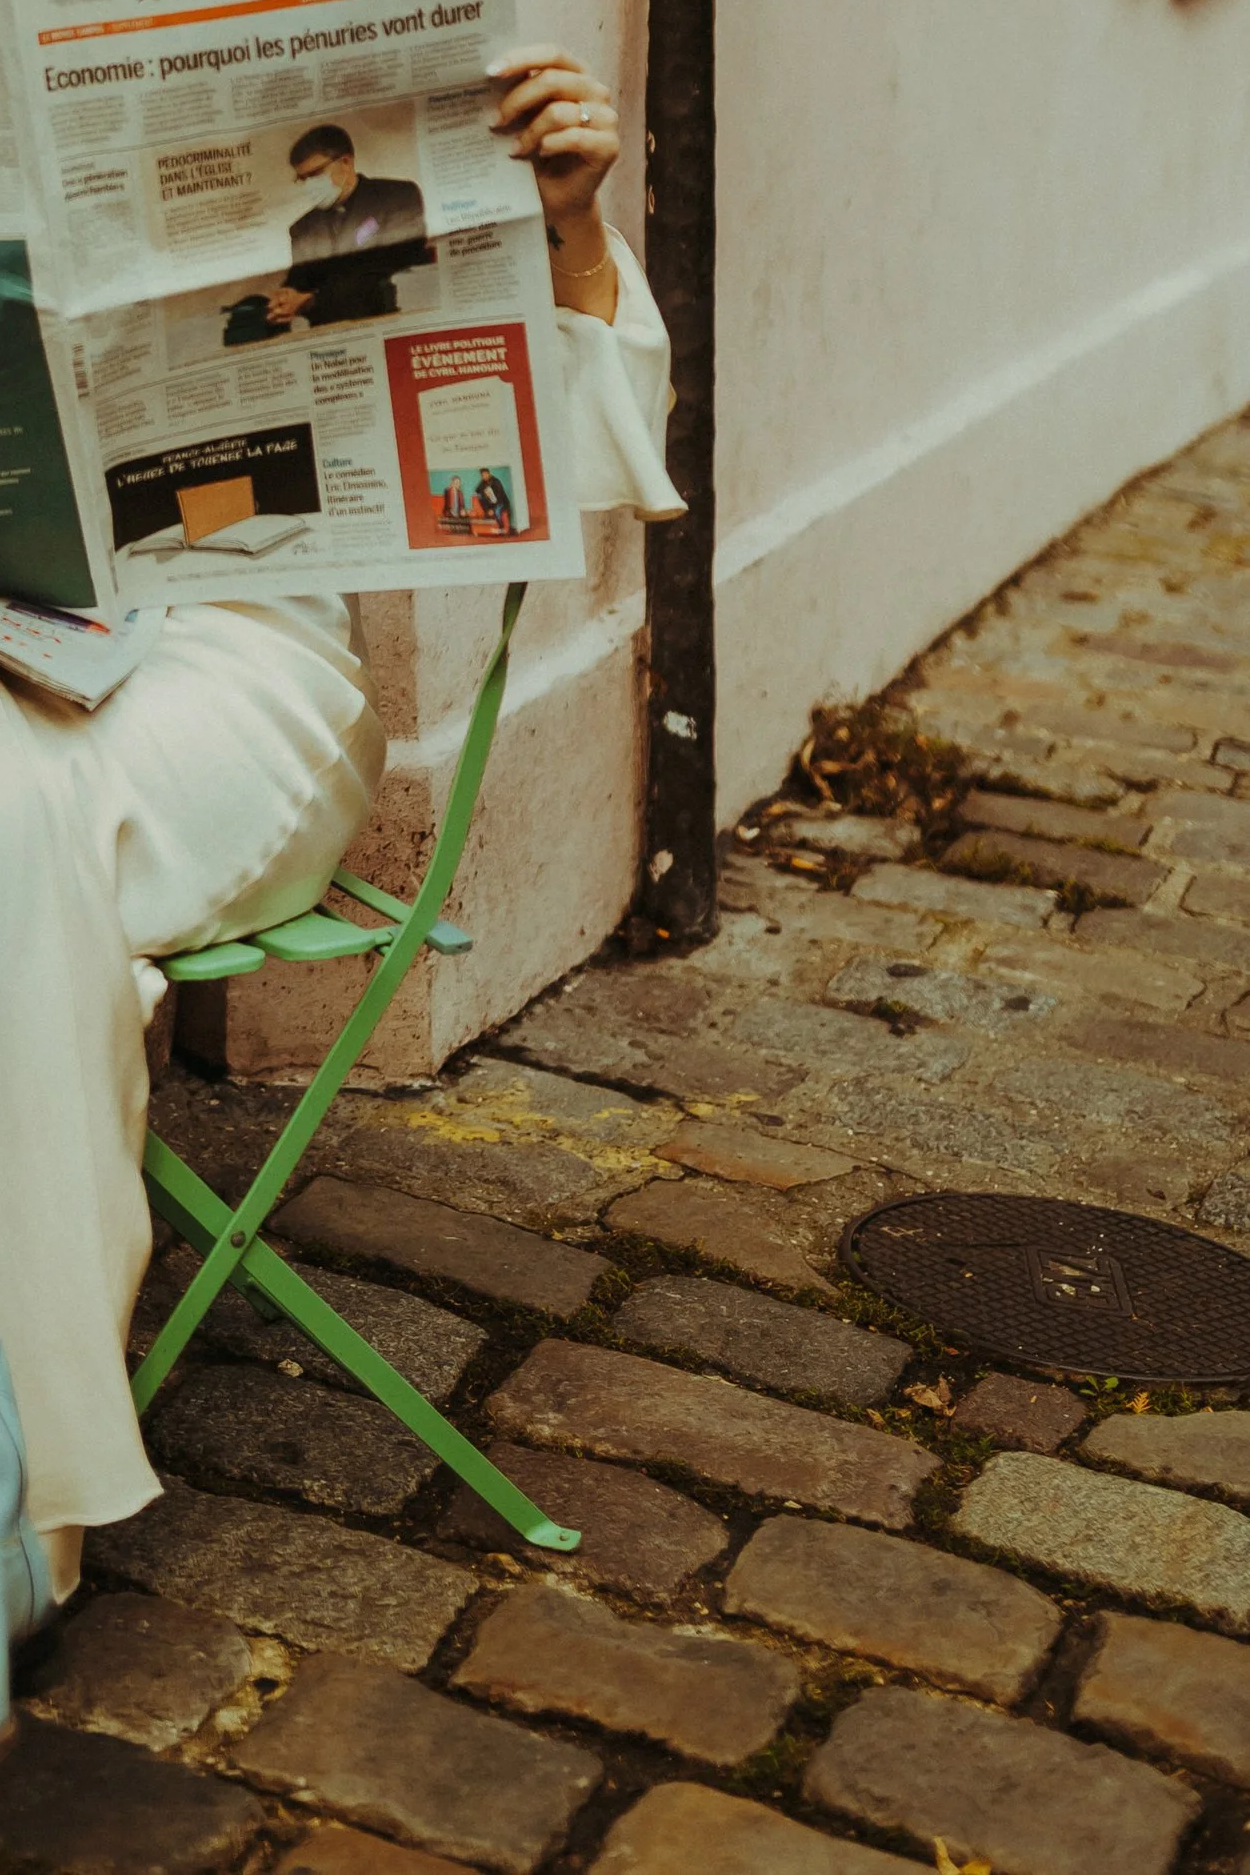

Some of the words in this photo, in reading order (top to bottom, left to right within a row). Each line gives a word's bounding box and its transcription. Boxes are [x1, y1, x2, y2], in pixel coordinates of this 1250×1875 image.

[44, 55, 145, 93] Economie
[159, 37, 251, 81] pourquoi
[255, 36, 285, 60] les
[289, 21, 378, 61] pénuries
[381, 6, 427, 38] vont
[430, 0, 485, 29] durer
[158, 170, 188, 186] DANS
[161, 186, 174, 202] ET
[176, 175, 244, 198] MAINTENANT
[410, 344, 423, 356] LE
[424, 340, 451, 354] LIVRE
[453, 334, 506, 349] POLITIQUE
[247, 445, 262, 458] LA
